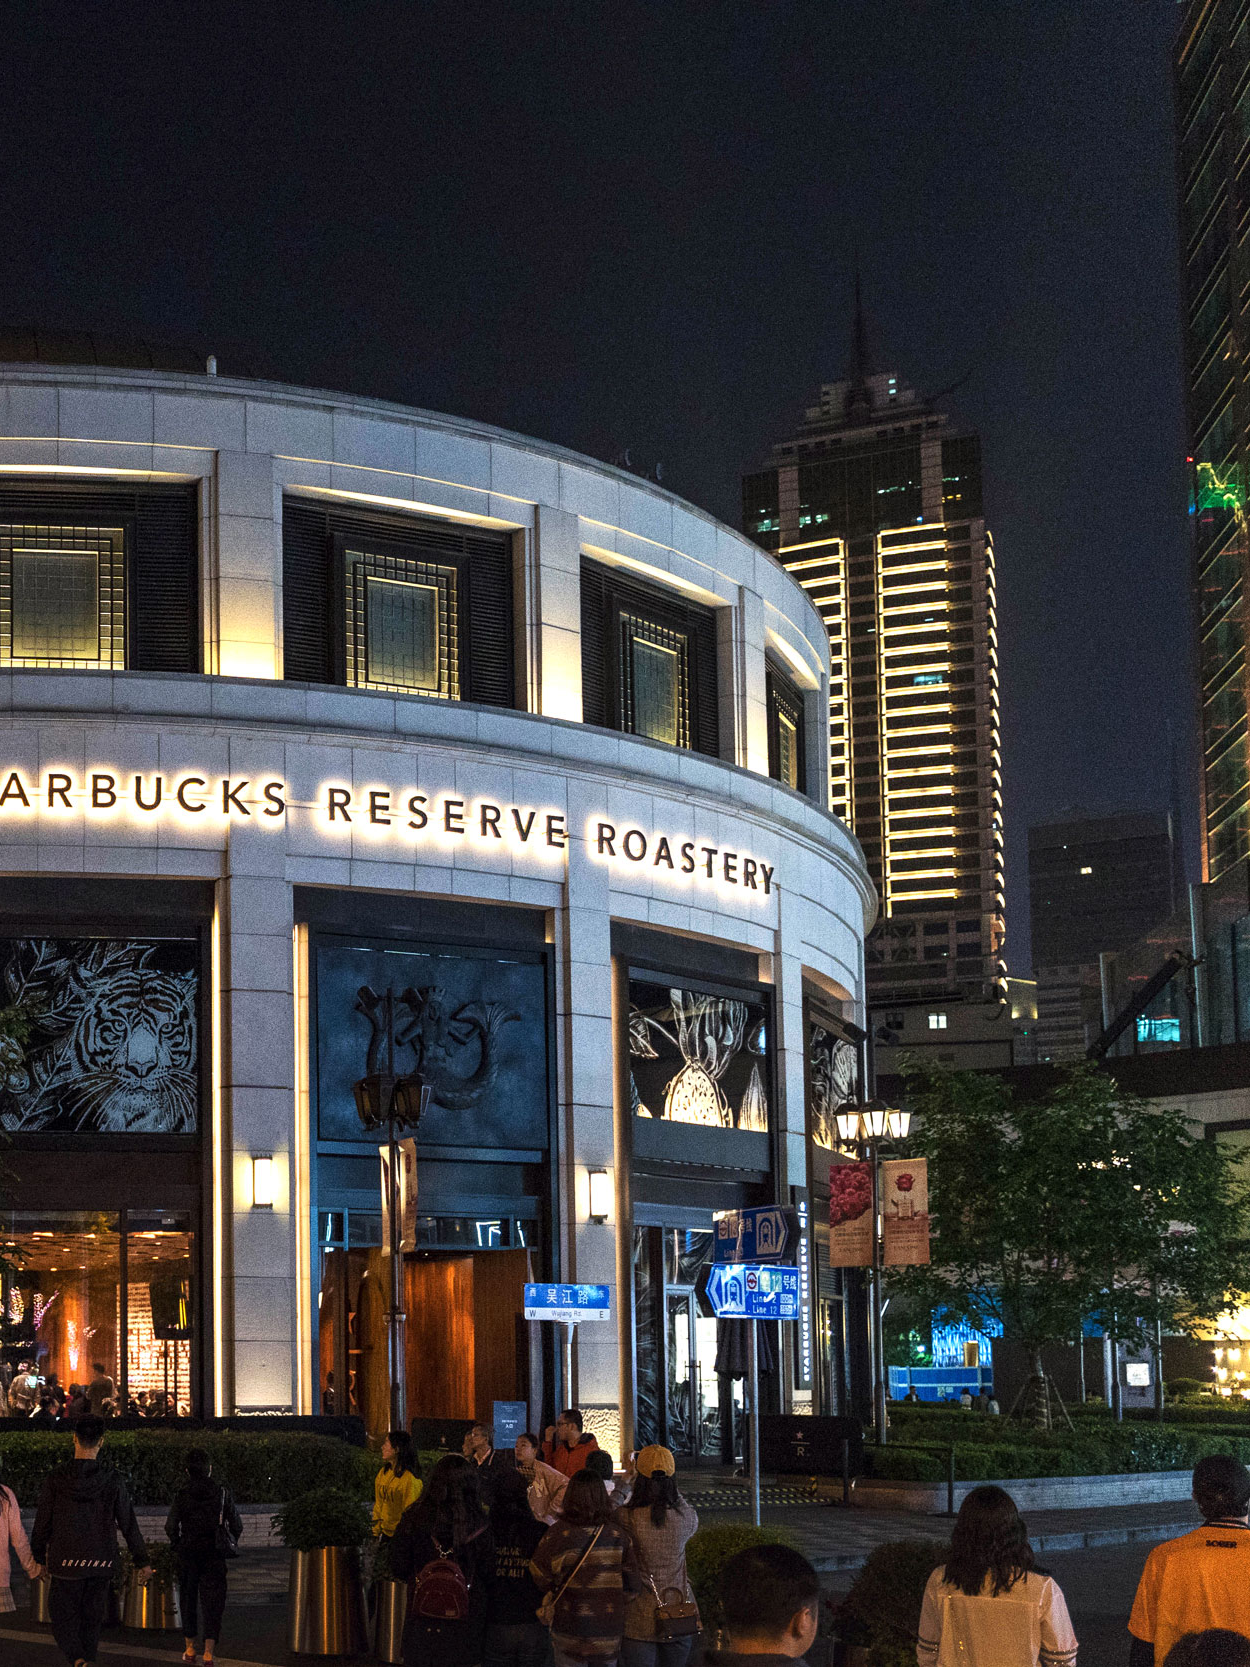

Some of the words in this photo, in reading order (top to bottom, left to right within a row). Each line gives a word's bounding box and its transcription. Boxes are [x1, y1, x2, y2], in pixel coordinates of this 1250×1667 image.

[328, 787, 565, 849] RESERVE
[596, 822, 775, 896] ROASTERY
[529, 1287, 537, 1297] 西
[546, 1288, 589, 1305] 吴江路
[598, 1290, 605, 1299] 东
[529, 1309, 537, 1318] W
[551, 1309, 573, 1318] Wujiang
[599, 1310, 605, 1319] E
[752, 1305, 767, 1315] Line
[770, 1306, 778, 1315] 12
[796, 1446, 805, 1457] R
[1205, 1539, 1238, 1549] SOBER
[61, 1559, 114, 1568] ORIGINAL
